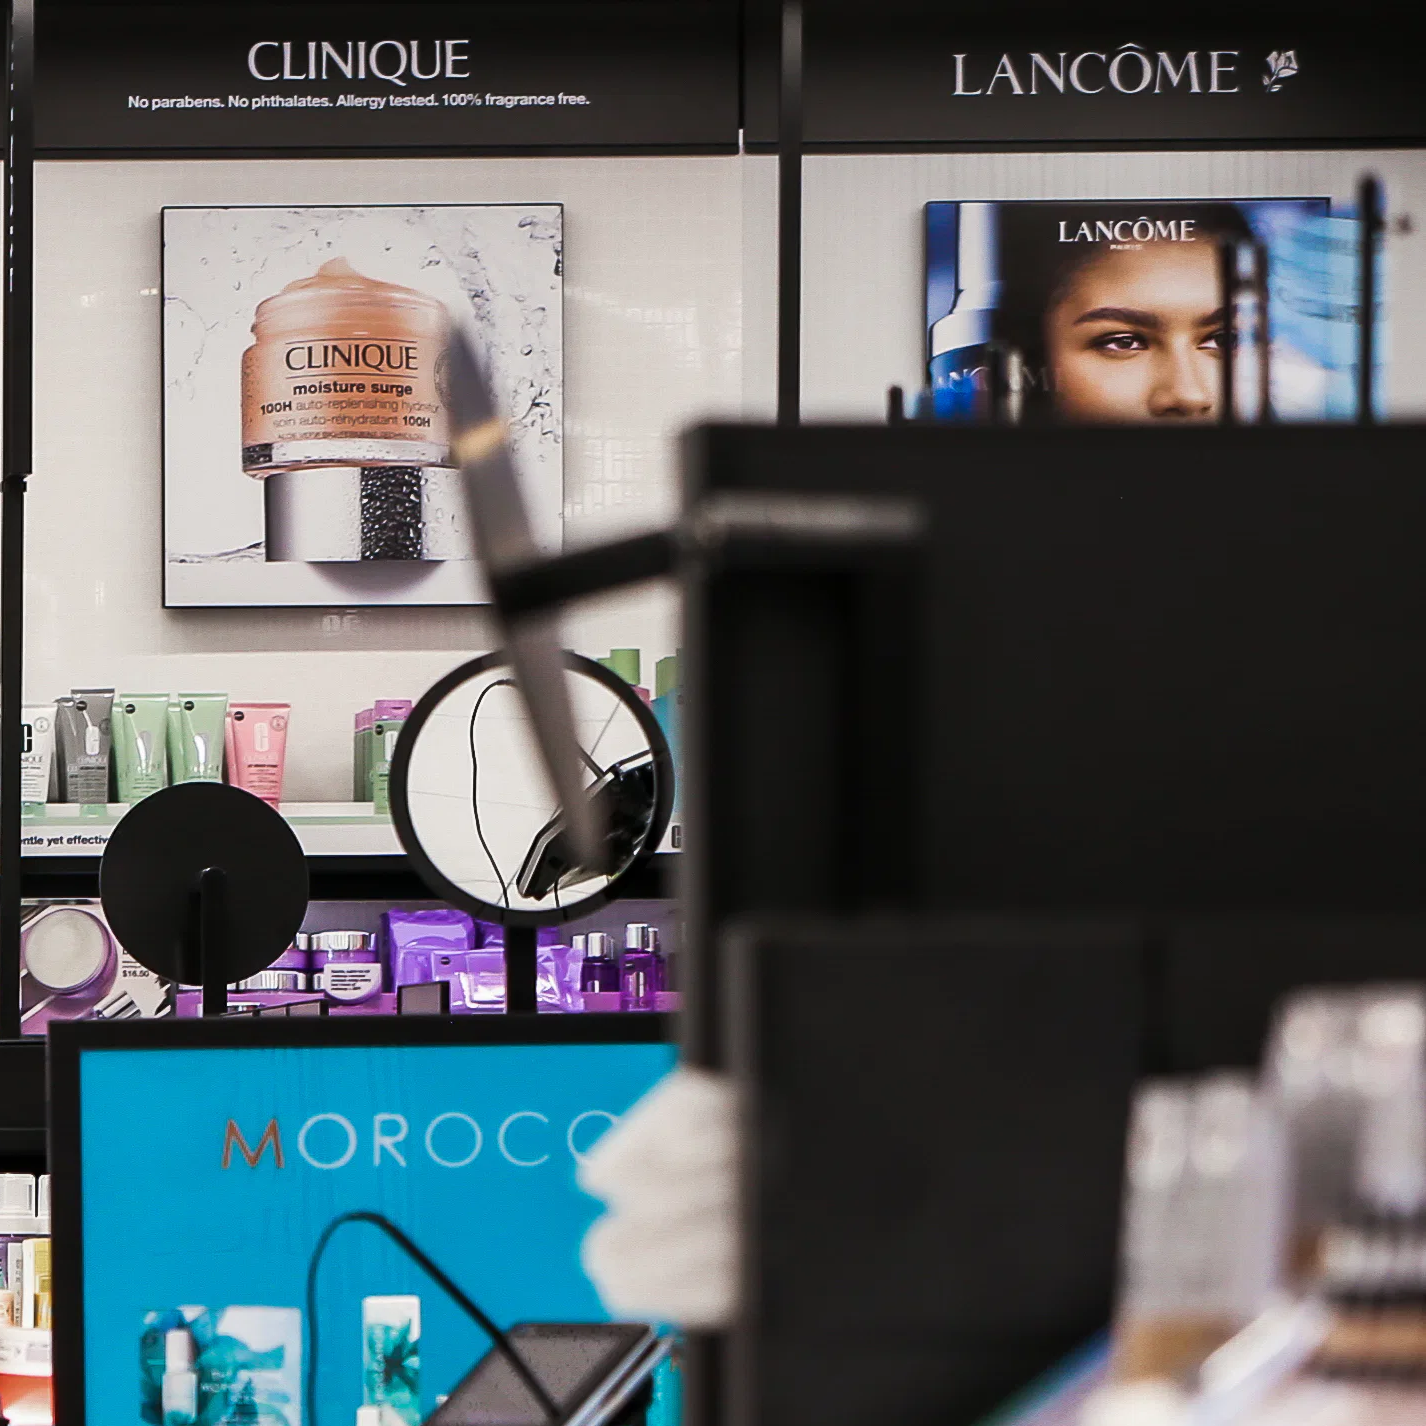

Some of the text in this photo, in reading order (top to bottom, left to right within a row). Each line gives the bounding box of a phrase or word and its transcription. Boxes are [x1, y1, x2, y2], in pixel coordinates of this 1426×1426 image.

[248, 40, 471, 86] CLINIQUE
[952, 43, 1240, 96] LANCÔME
[128, 93, 590, 111] No parabens. No phthalates. Allergy tested. 100% fragrance free.
[1058, 216, 1196, 243] LANCÔME
[285, 343, 418, 372] CLINIQUE
[293, 381, 413, 397] moisture surge
[46, 836, 64, 847] yet
[67, 835, 111, 845] effectiv
